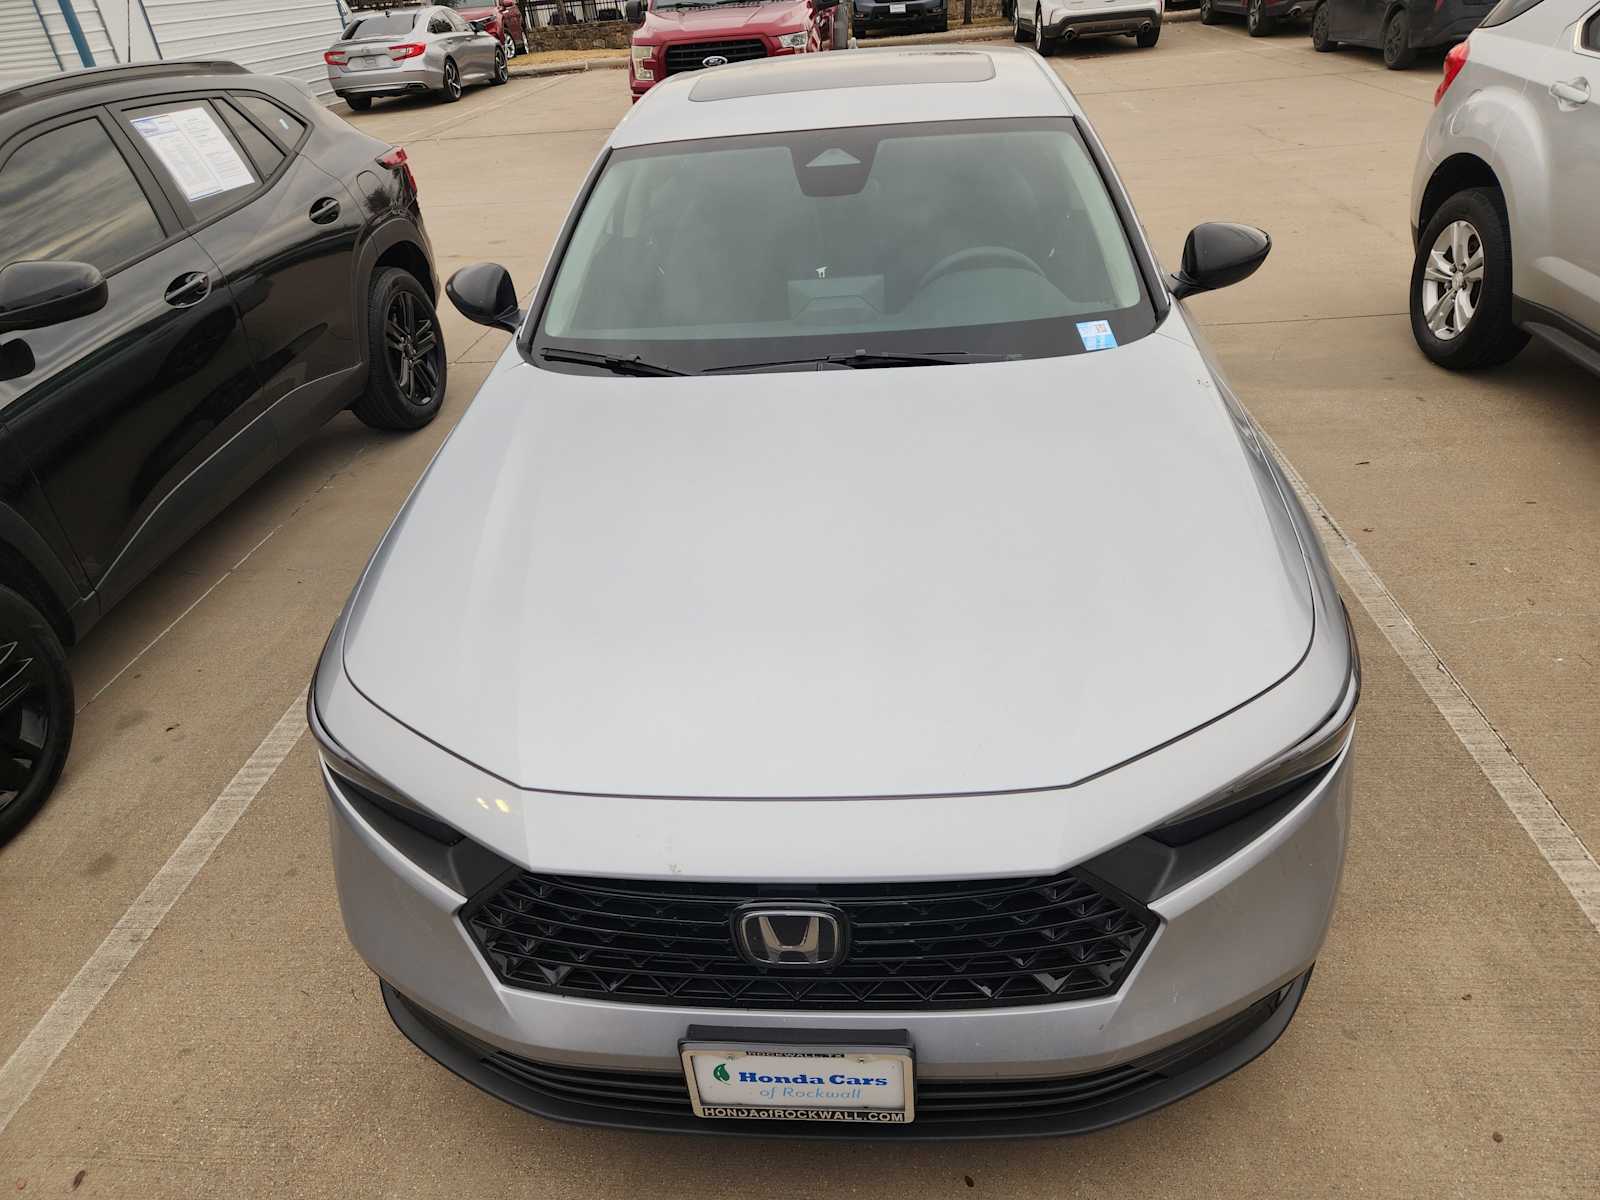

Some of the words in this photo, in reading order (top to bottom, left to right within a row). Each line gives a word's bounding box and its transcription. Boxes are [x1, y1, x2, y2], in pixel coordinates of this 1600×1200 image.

[738, 1071, 825, 1085] Honda
[828, 1074, 889, 1087] Cars
[759, 1087, 778, 1100] of
[782, 1086, 862, 1100] Rockwall
